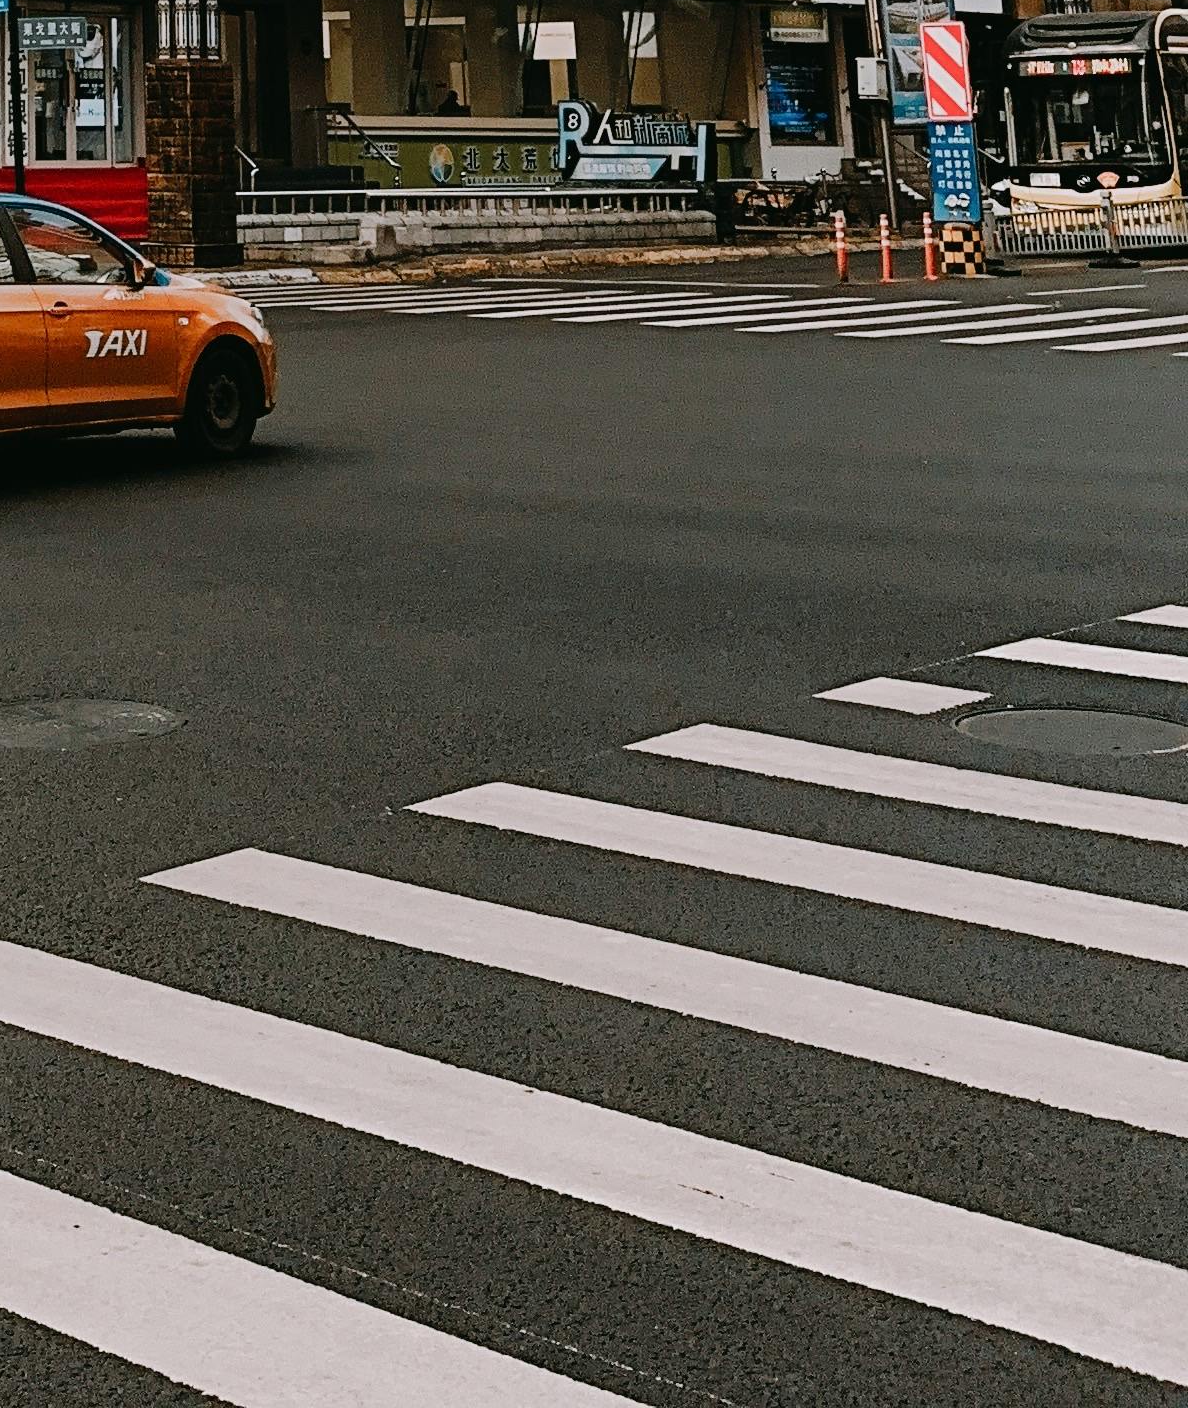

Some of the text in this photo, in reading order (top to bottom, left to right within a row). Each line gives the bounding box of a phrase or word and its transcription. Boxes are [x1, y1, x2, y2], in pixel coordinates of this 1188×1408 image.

[23, 22, 81, 36] 果戈里大街
[593, 109, 690, 144] 人和新商城
[84, 329, 148, 358] TAXI
